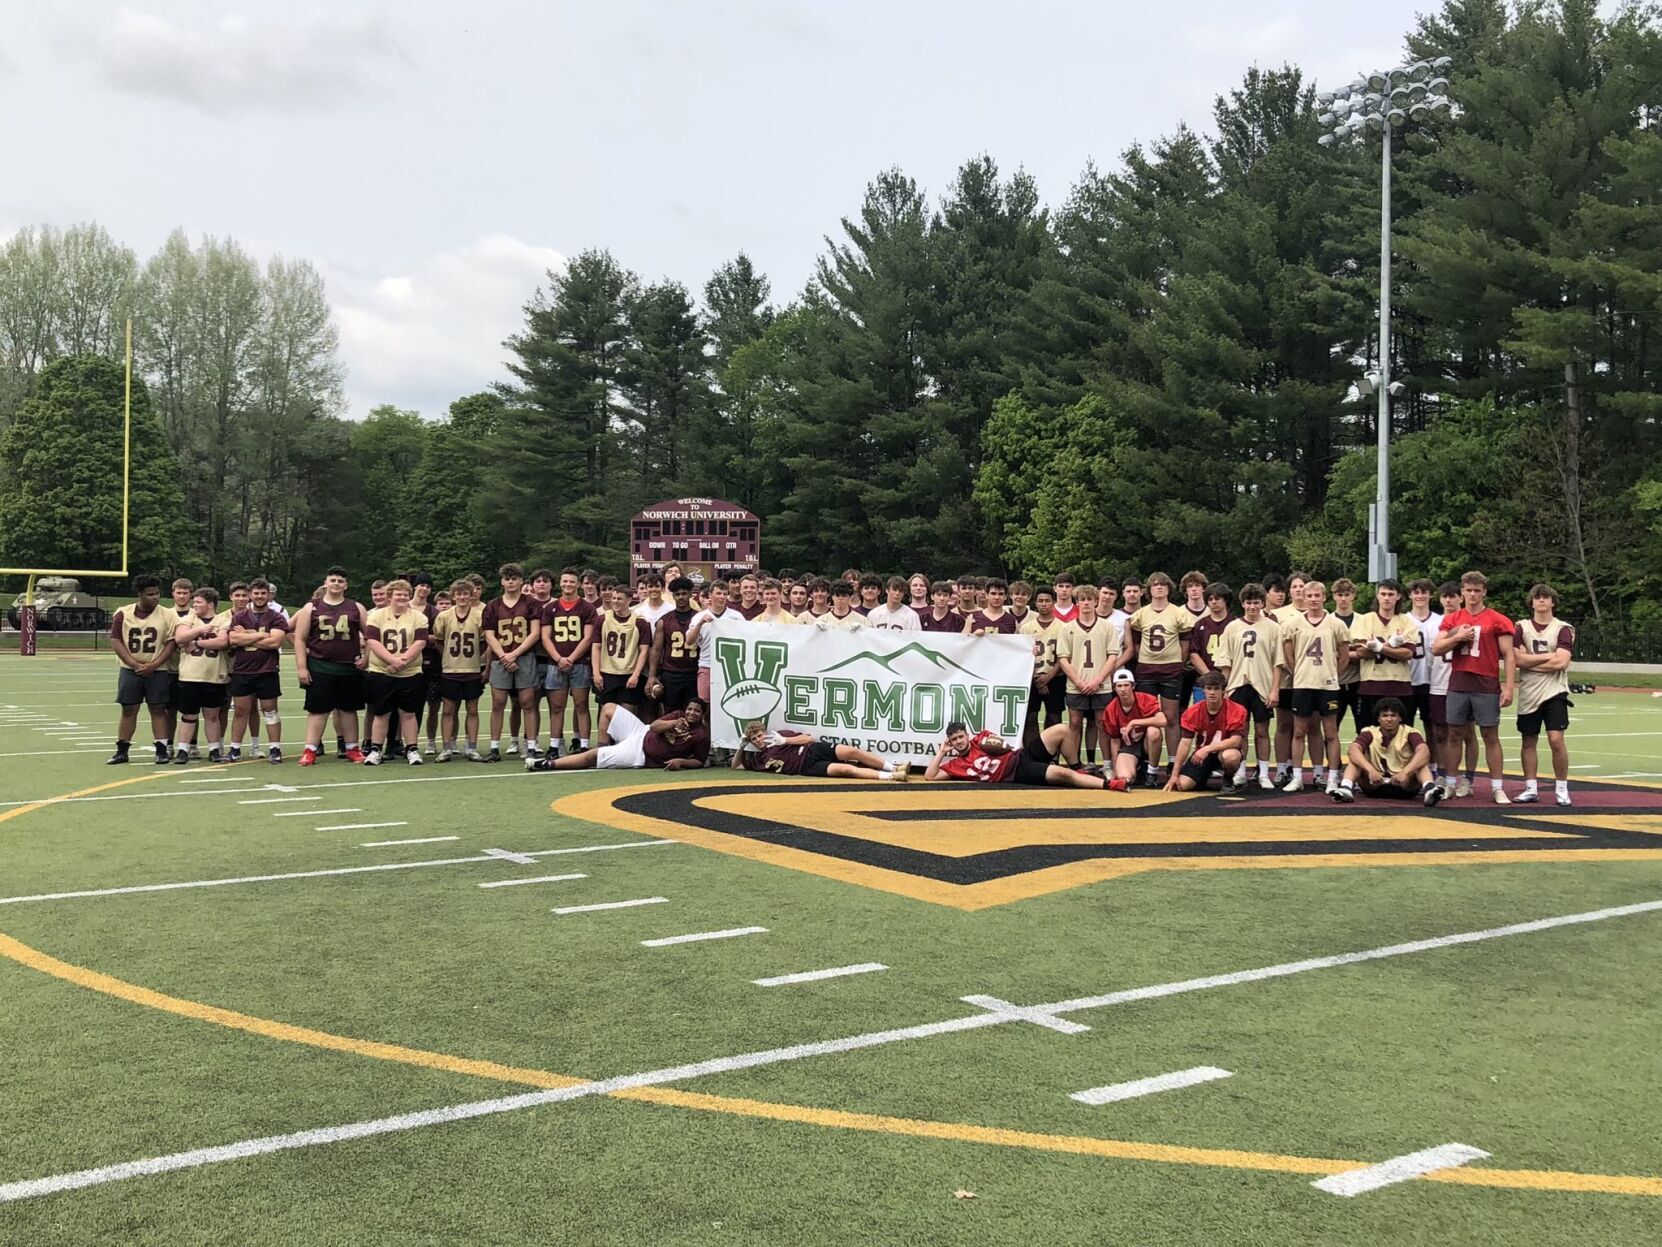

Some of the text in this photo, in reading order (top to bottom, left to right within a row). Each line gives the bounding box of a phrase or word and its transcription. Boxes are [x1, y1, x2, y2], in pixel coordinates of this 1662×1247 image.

[642, 510, 748, 519] NORWICH UNIVERSITY
[677, 497, 713, 506] WELCOME
[649, 541, 666, 549] DOWN
[26, 607, 34, 654] NORWICH
[128, 627, 157, 654] 62
[318, 614, 350, 641] 54
[382, 628, 409, 654] 61
[497, 616, 528, 647] 53
[554, 615, 582, 643] 59
[1149, 624, 1166, 652] 6
[449, 631, 475, 659] 35
[606, 631, 627, 659] 81
[1083, 639, 1094, 668] 1
[1242, 630, 1258, 659] 2
[1305, 636, 1324, 666] 4
[716, 636, 1030, 740] VERMONT
